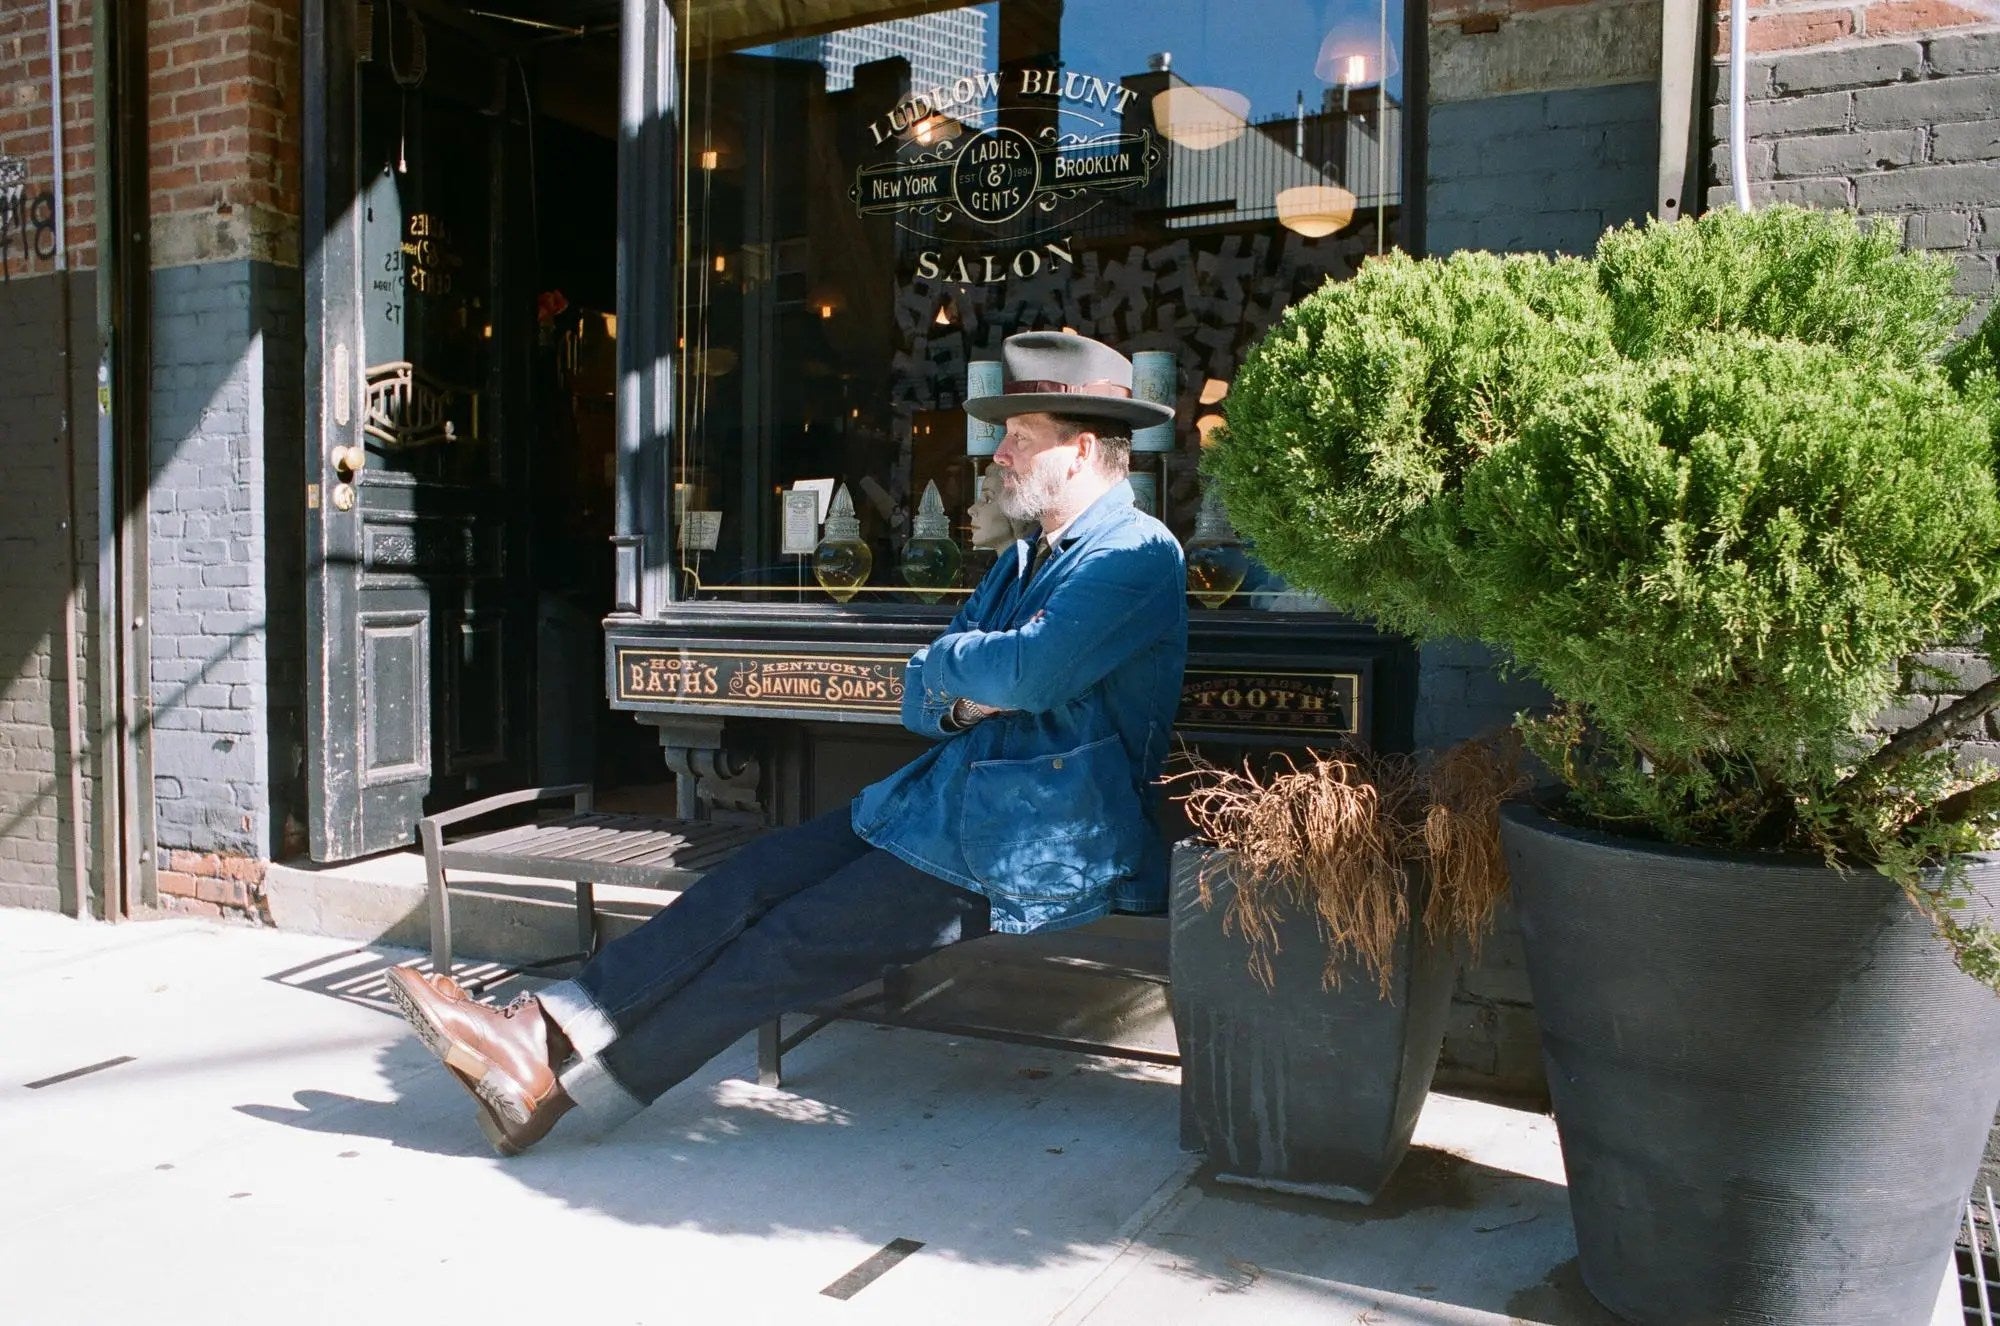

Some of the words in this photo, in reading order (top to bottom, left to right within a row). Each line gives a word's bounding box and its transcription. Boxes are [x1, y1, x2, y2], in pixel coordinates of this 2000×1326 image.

[868, 71, 1003, 146] LUDLOW
[1020, 69, 1138, 116] BLUNT
[971, 140, 1021, 165] LADIES
[1054, 154, 1130, 179] BROOKLYN
[872, 178, 902, 199] NEW
[903, 175, 937, 196] YORK
[971, 188, 1021, 212] GENTS
[915, 236, 1074, 284] SALON
[650, 659, 698, 671] HOT
[762, 661, 871, 678] KENTUCKY
[630, 663, 718, 695] BATHS
[746, 672, 821, 698] SHAVING
[825, 675, 887, 701] SOAPS
[1194, 688, 1325, 710] TOOTH
